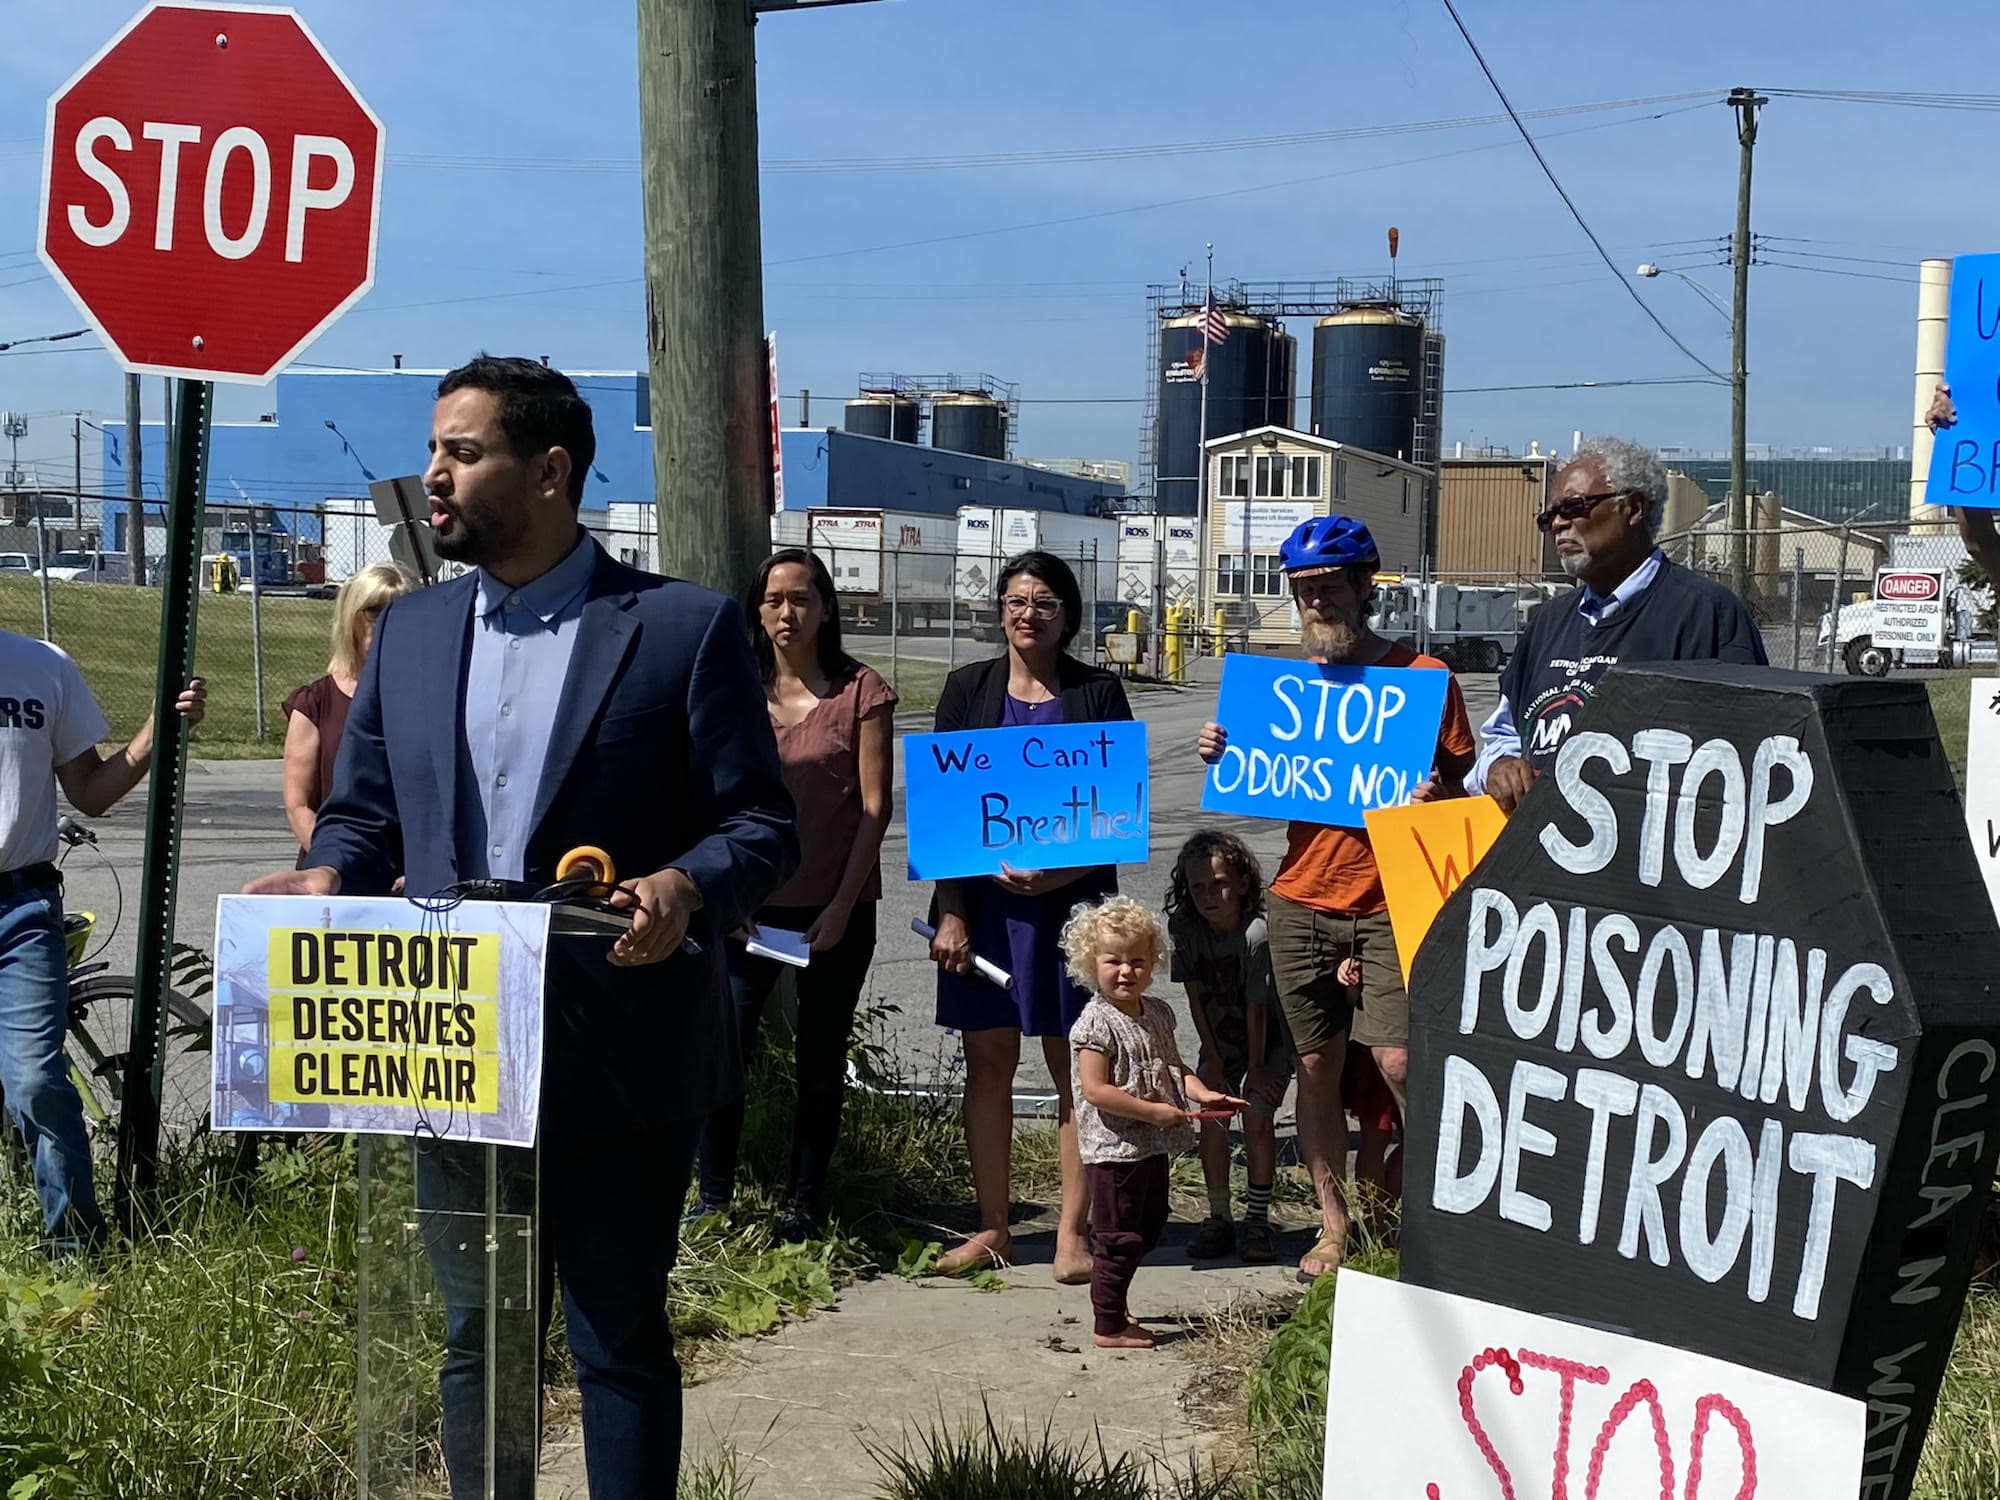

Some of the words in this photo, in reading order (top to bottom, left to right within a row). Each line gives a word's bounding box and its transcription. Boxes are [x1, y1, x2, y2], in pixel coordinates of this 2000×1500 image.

[67, 116, 356, 264] STOP
[816, 520, 839, 528] XTRA
[853, 520, 876, 529] XTRA
[900, 524, 922, 547] XTRA
[967, 519, 989, 529] ROSS
[1125, 527, 1149, 537] ROSS
[1170, 528, 1194, 538] ROSS
[1876, 603, 1918, 613] RESTRICTED
[1918, 604, 1939, 614] AREA
[1885, 580, 1931, 594] DANGER
[1874, 631, 1915, 641] PERSONNEL
[1916, 632, 1937, 642] ONLY
[1883, 617, 1929, 628] AUTHORIZED
[1269, 673, 1407, 745] STOP
[1523, 686, 1560, 720] NATIONAL
[931, 742, 992, 774] We
[1022, 729, 1116, 769] Can't
[1212, 745, 1334, 802] ODORS
[980, 781, 1144, 849] Breathe!
[1538, 728, 1815, 905] STOP
[292, 932, 478, 991] DETROIT
[293, 997, 476, 1048] DESERVES
[1458, 887, 1900, 1123] POISONING
[294, 1052, 408, 1098] CLEAN
[422, 1057, 477, 1104] AIR
[1431, 1053, 1877, 1320] DETROIT
[1890, 1038, 1997, 1304] CLEAN
